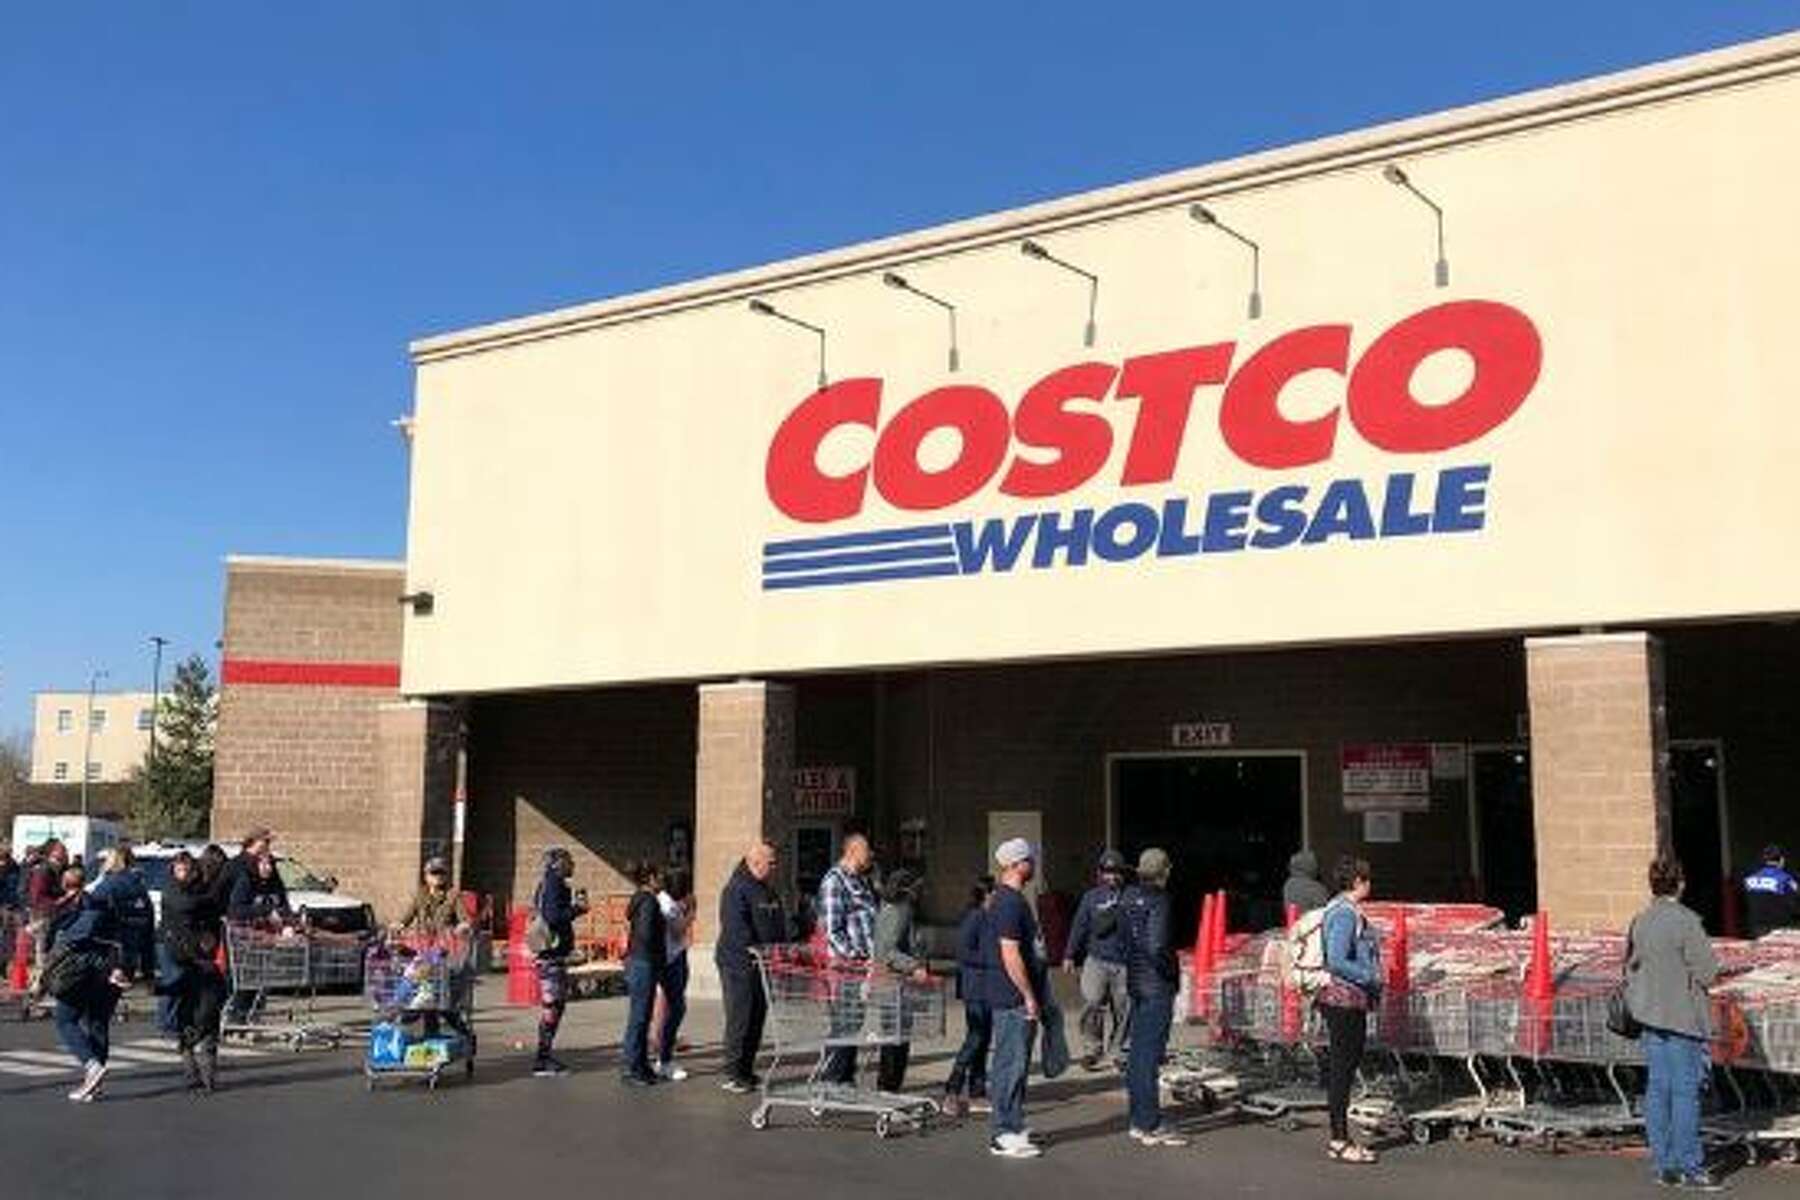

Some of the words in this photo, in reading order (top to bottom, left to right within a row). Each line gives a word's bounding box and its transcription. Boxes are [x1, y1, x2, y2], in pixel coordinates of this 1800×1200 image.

[765, 300, 1542, 523] COSTCO
[952, 464, 1489, 575] WHOLESALE
[1180, 724, 1226, 744] EXIT
